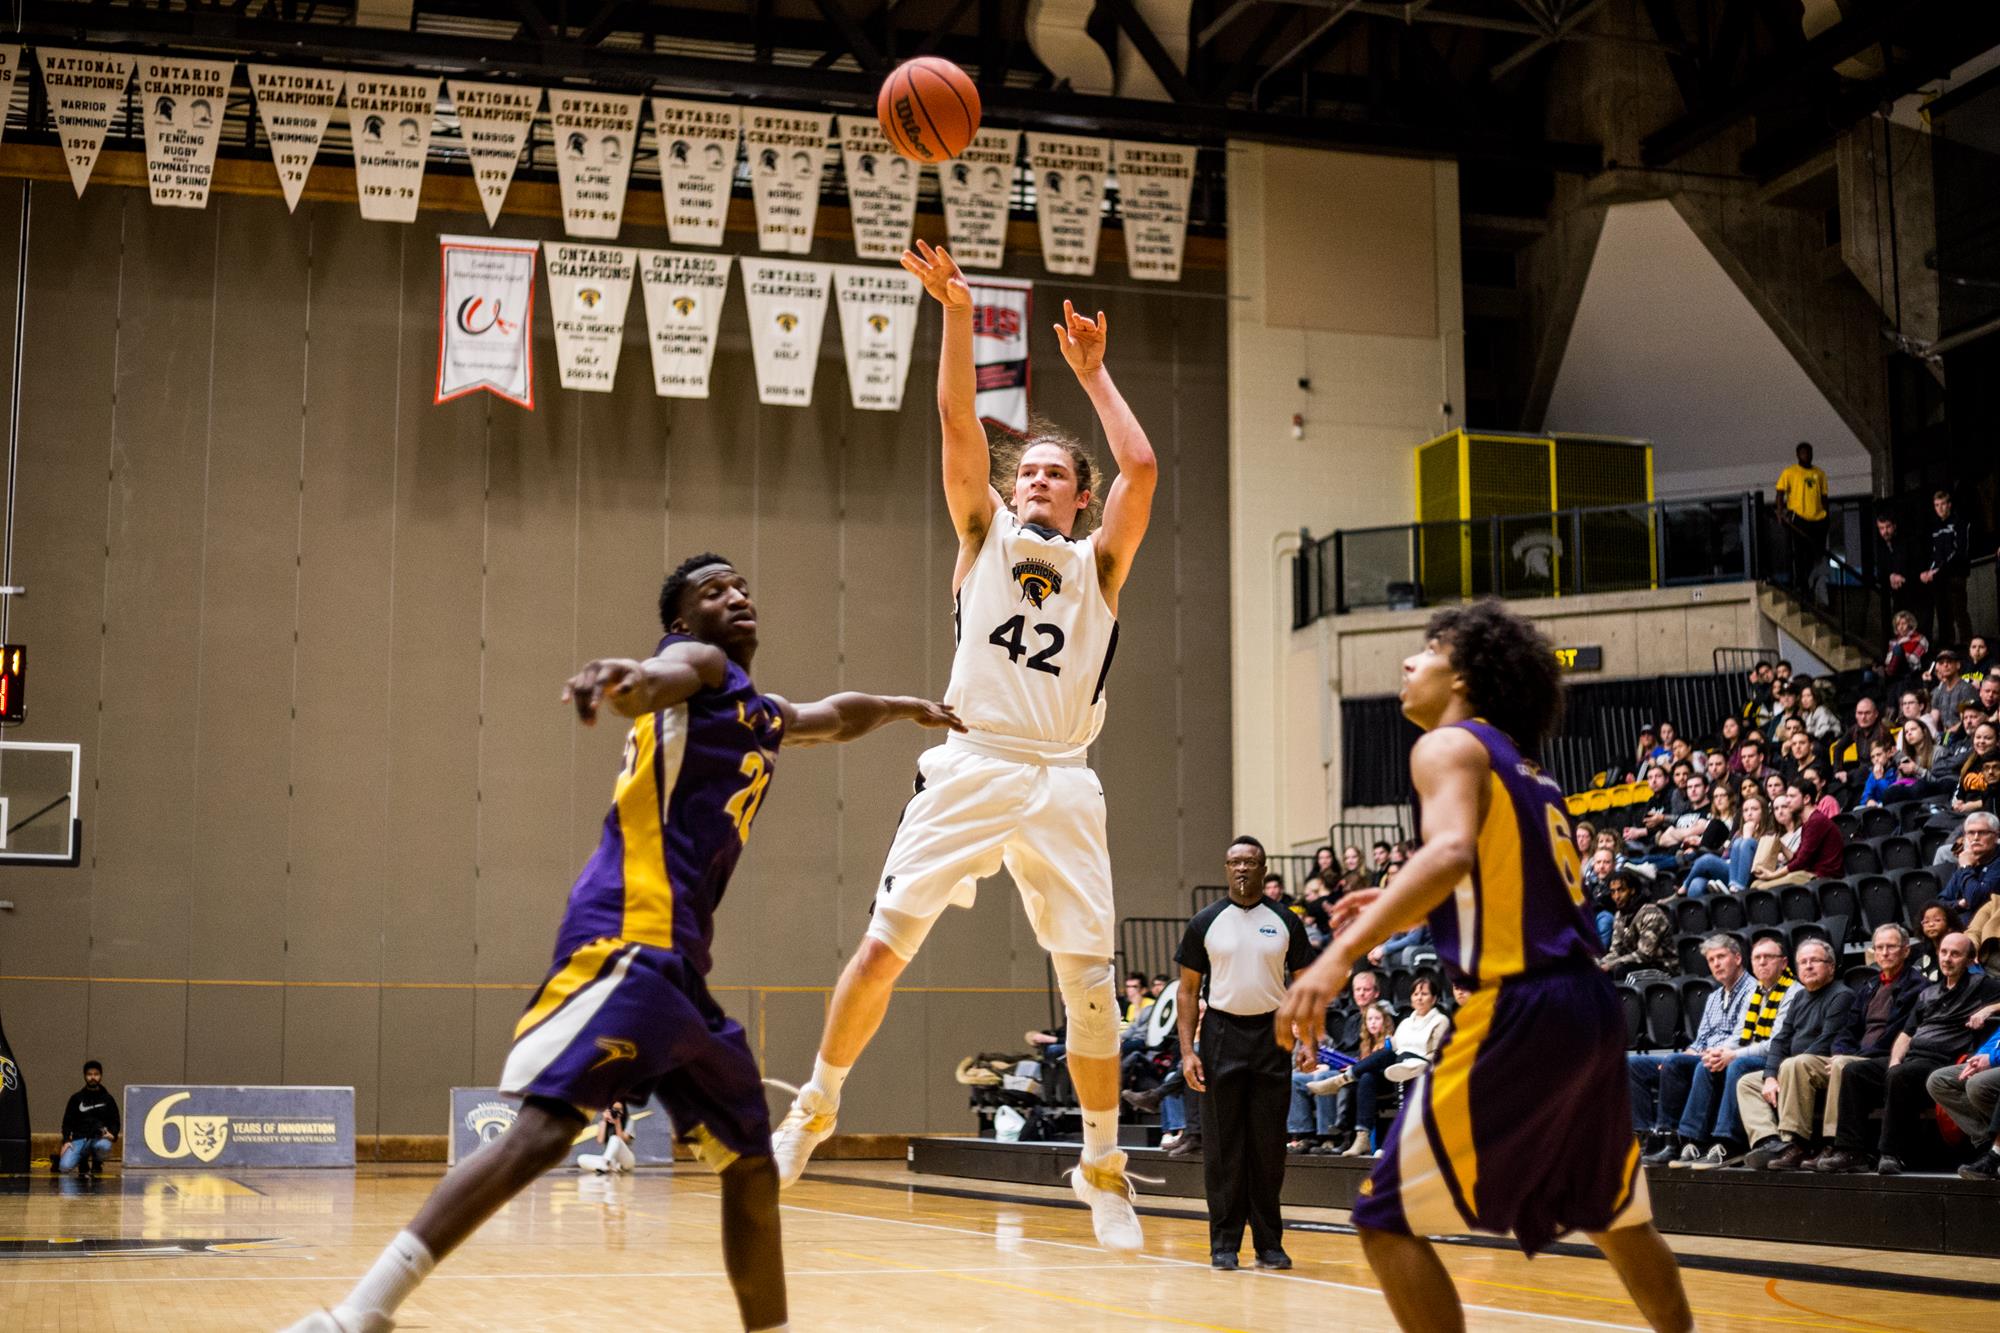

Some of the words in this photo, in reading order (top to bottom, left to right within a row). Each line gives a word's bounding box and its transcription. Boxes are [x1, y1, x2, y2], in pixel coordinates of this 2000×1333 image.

[46, 57, 125, 74] NATIONAL
[150, 65, 221, 82] ONTARIO
[46, 73, 125, 90] CHAMPIONS
[144, 81, 225, 98] CHAMPIONS
[257, 73, 335, 91] NATIONAL
[257, 89, 335, 107] CHAMPIONS
[357, 82, 427, 99] ONTARIO
[456, 89, 533, 108] NATIONAL
[61, 99, 107, 111] WARRIOR
[351, 98, 432, 115] CHAMPIONS
[561, 99, 629, 116] ONTARIO
[58, 115, 107, 128] SWIMMING
[272, 116, 317, 128] WARRIOR
[456, 105, 532, 123] CHAMPIONS
[664, 108, 731, 125] ONTARIO
[555, 114, 634, 132] CHAMPIONS
[658, 122, 737, 141] CHAMPIONS
[754, 116, 820, 133] ONTARIO
[158, 133, 204, 145] FENCING
[270, 132, 318, 144] SWIMMING
[472, 131, 516, 143] WARRIOR
[748, 131, 824, 148] CHAMPIONS
[973, 137, 1008, 149] ARIO
[163, 146, 198, 158] RUGBY
[957, 150, 1012, 164] AMPIONS
[1038, 142, 1101, 157] ONTARIO
[1125, 149, 1183, 164] ONTARIO
[150, 161, 211, 174] GYMNASTICS
[360, 155, 419, 169] BADMINTON
[1033, 156, 1105, 172] CHAMPIONS
[1119, 162, 1190, 179] CHAMPIONS
[152, 174, 172, 184] ALP
[175, 175, 208, 187] SKIING
[574, 175, 612, 185] ALPINE
[576, 190, 610, 201] SKIING
[558, 246, 624, 264] ONTARIO
[652, 255, 717, 272] ONTARIO
[549, 262, 632, 281] CHAMPIONS
[644, 269, 725, 288] CHAMPIONS
[758, 268, 817, 284] ONTARIO
[750, 283, 823, 300] CHAMPIONS
[848, 276, 908, 291] ONTARIO
[841, 290, 916, 306] CHAMPIONS
[1011, 563, 1063, 595] WARRIORS
[989, 614, 1065, 677] 42
[232, 1122, 262, 1134] YEARS
[263, 1122, 276, 1134] OF
[277, 1122, 336, 1134] INNOVATION
[232, 1135, 279, 1143] UNIVERSITY
